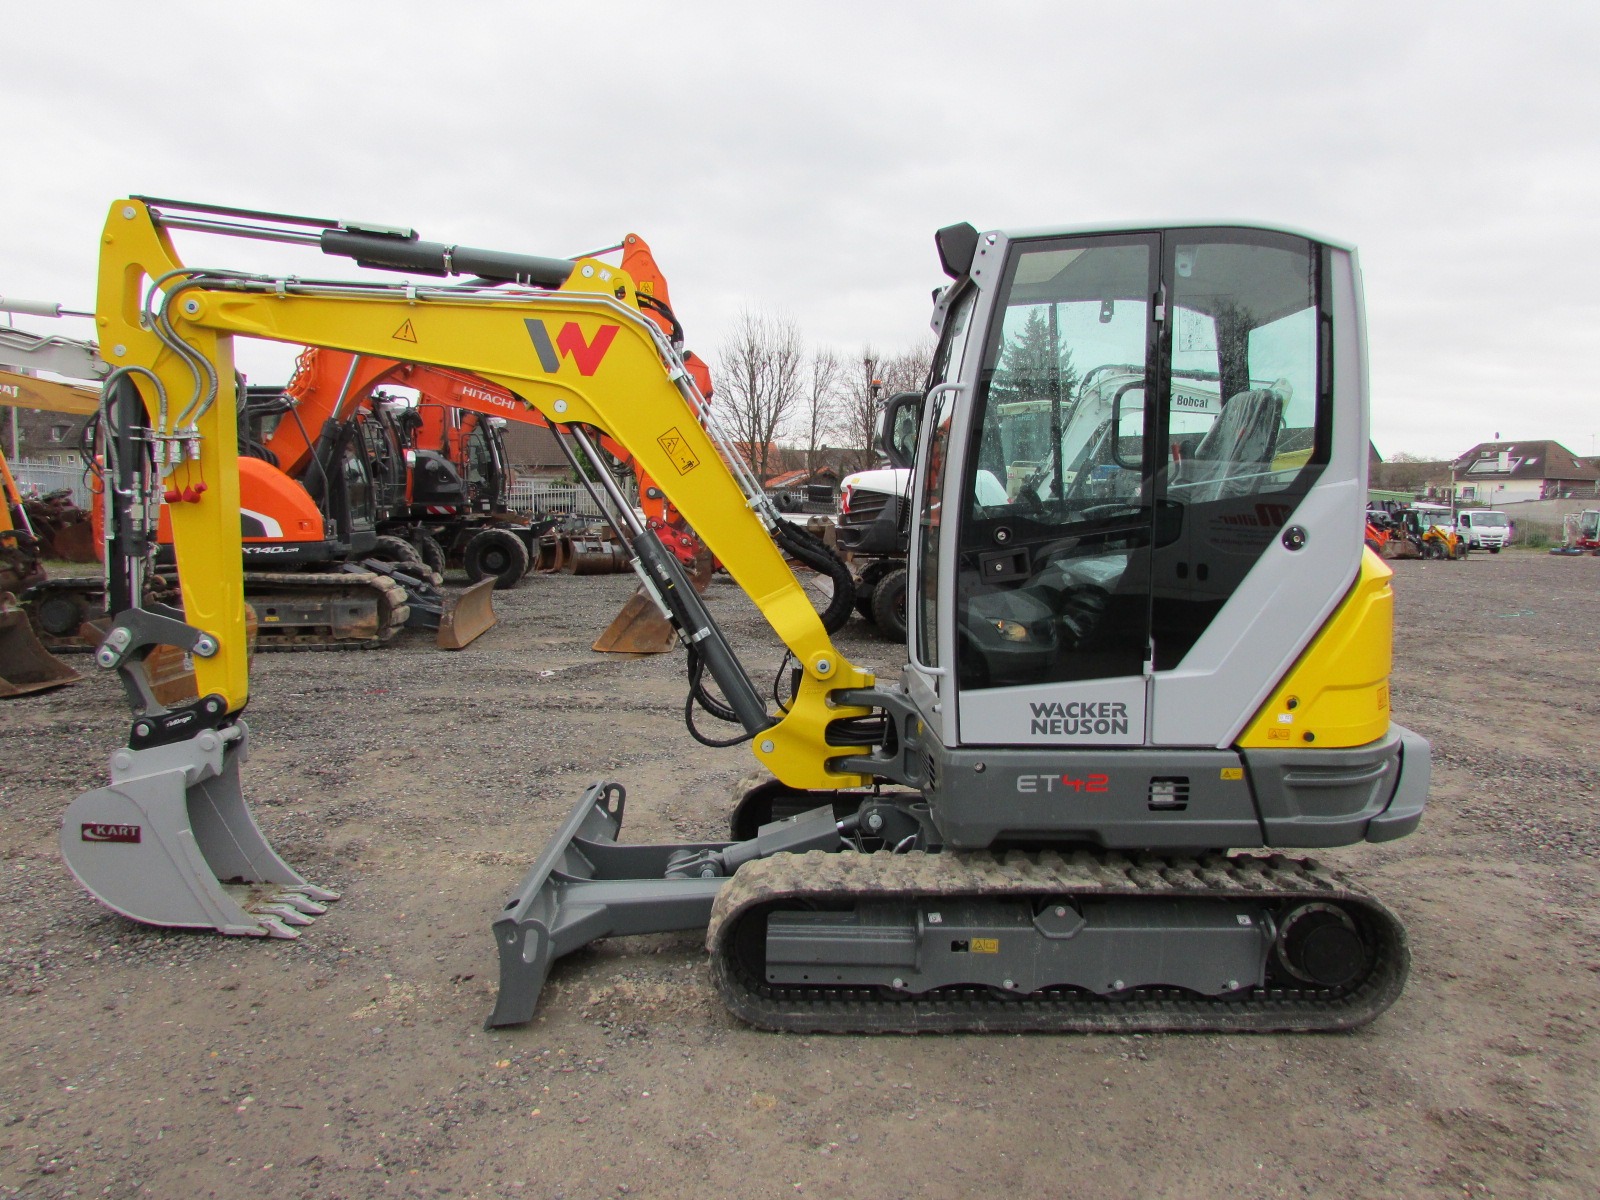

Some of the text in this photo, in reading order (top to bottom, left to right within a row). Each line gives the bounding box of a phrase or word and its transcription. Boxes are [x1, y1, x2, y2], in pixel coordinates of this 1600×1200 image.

[0, 384, 20, 398] AT
[462, 386, 516, 410] HITACHI
[1176, 394, 1209, 409] Bobcat
[1029, 702, 1129, 718] WACKER
[1030, 718, 1128, 735] NEUSON
[1016, 774, 1109, 793] ET42
[96, 825, 138, 837] KART
